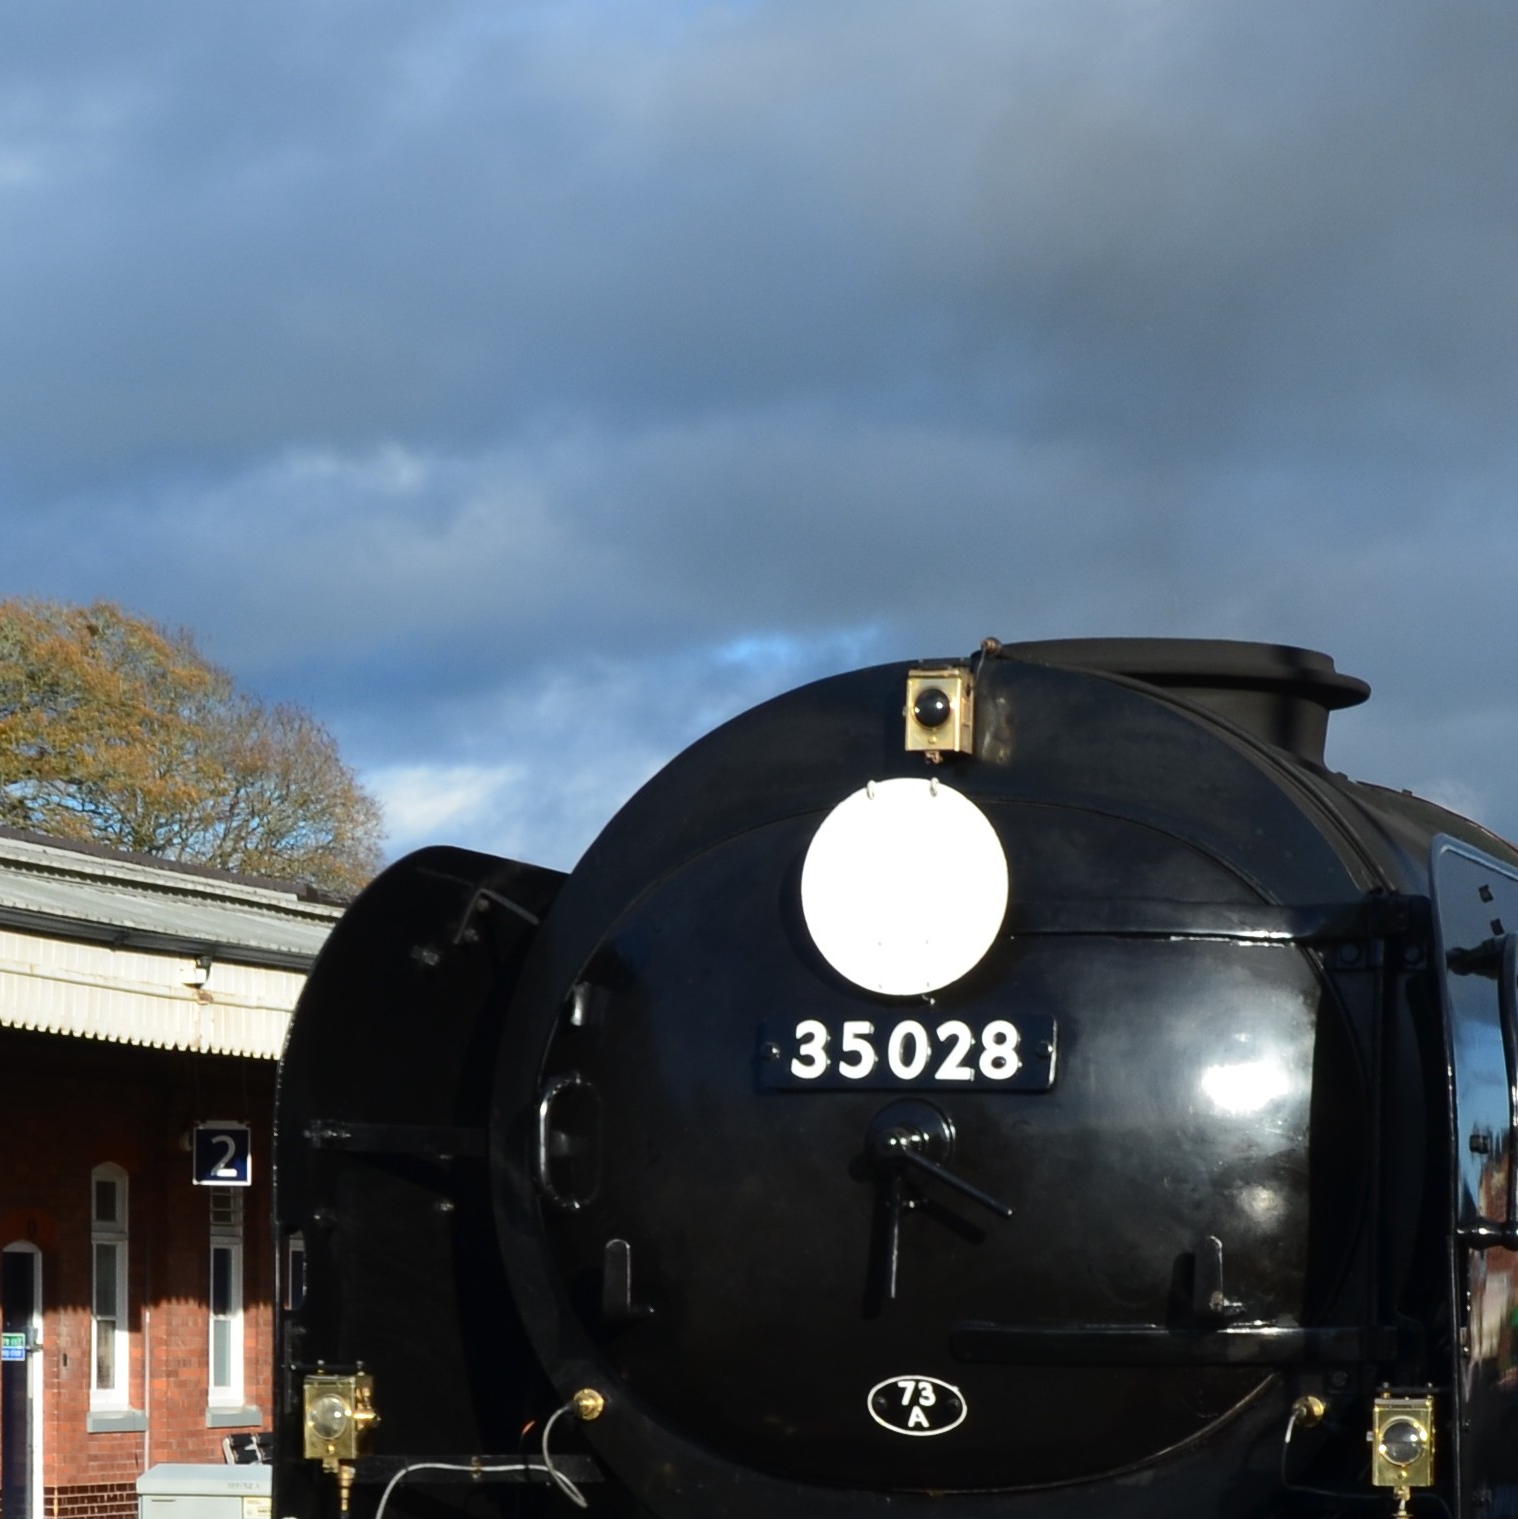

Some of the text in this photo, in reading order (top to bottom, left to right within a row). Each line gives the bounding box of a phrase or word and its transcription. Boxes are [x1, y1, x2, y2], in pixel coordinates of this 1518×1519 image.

[790, 1019, 1023, 1082] 35028
[210, 1134, 238, 1177] 2
[897, 1382, 936, 1407] 73
[908, 1407, 929, 1429] A
